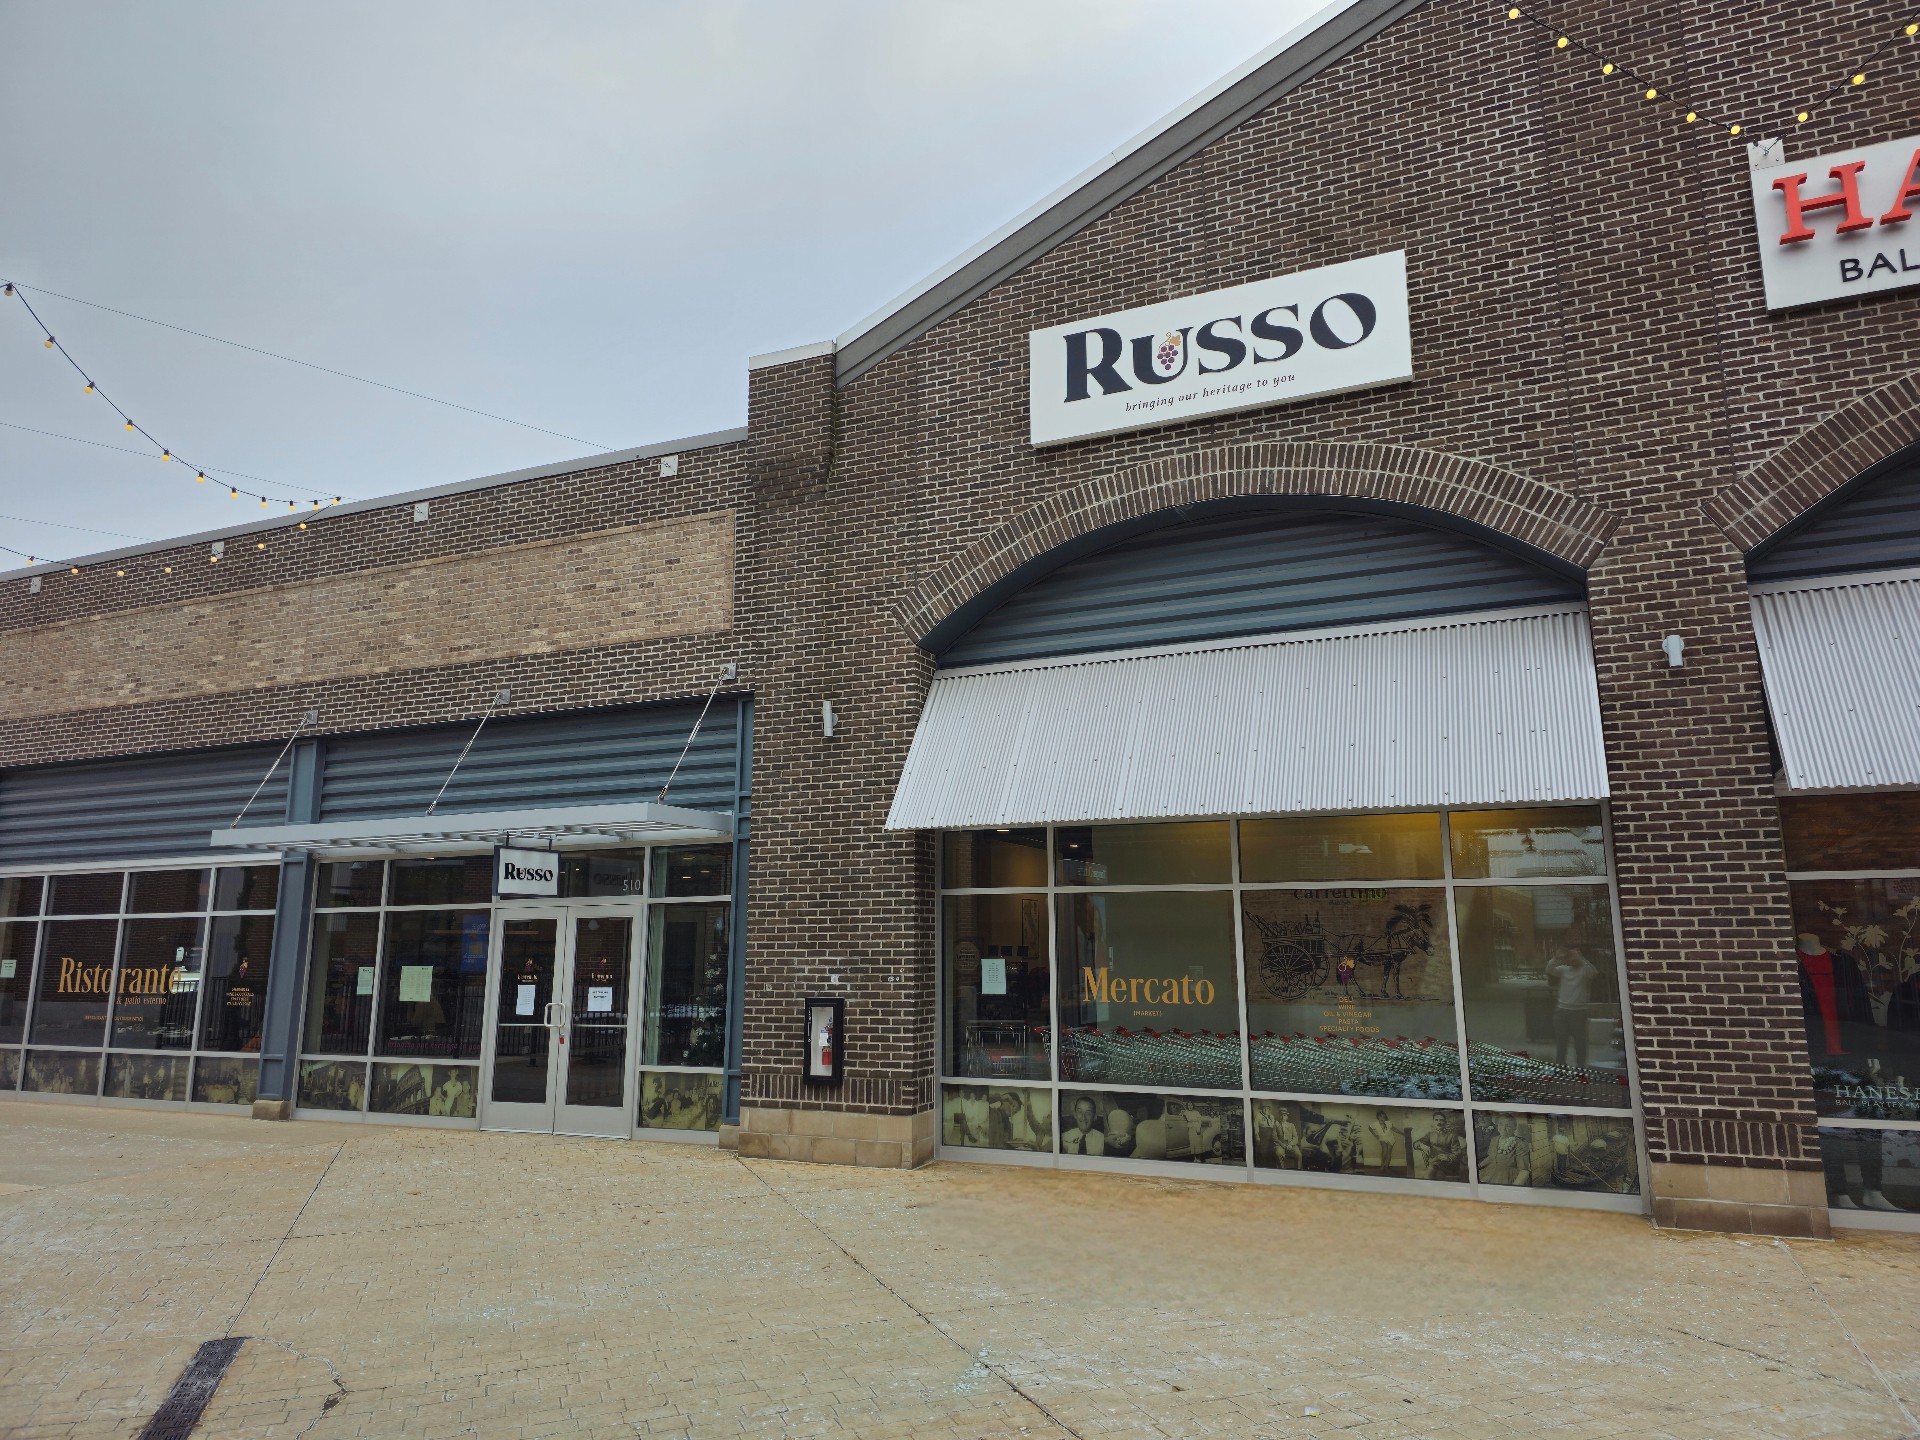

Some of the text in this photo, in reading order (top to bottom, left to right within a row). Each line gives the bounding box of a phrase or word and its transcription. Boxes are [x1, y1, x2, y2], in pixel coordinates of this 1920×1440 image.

[1125, 374, 1296, 412] bringing our heritage to you
[622, 879, 641, 891] 510
[57, 957, 183, 995] Ristorante
[1082, 966, 1215, 1005] Mercato
